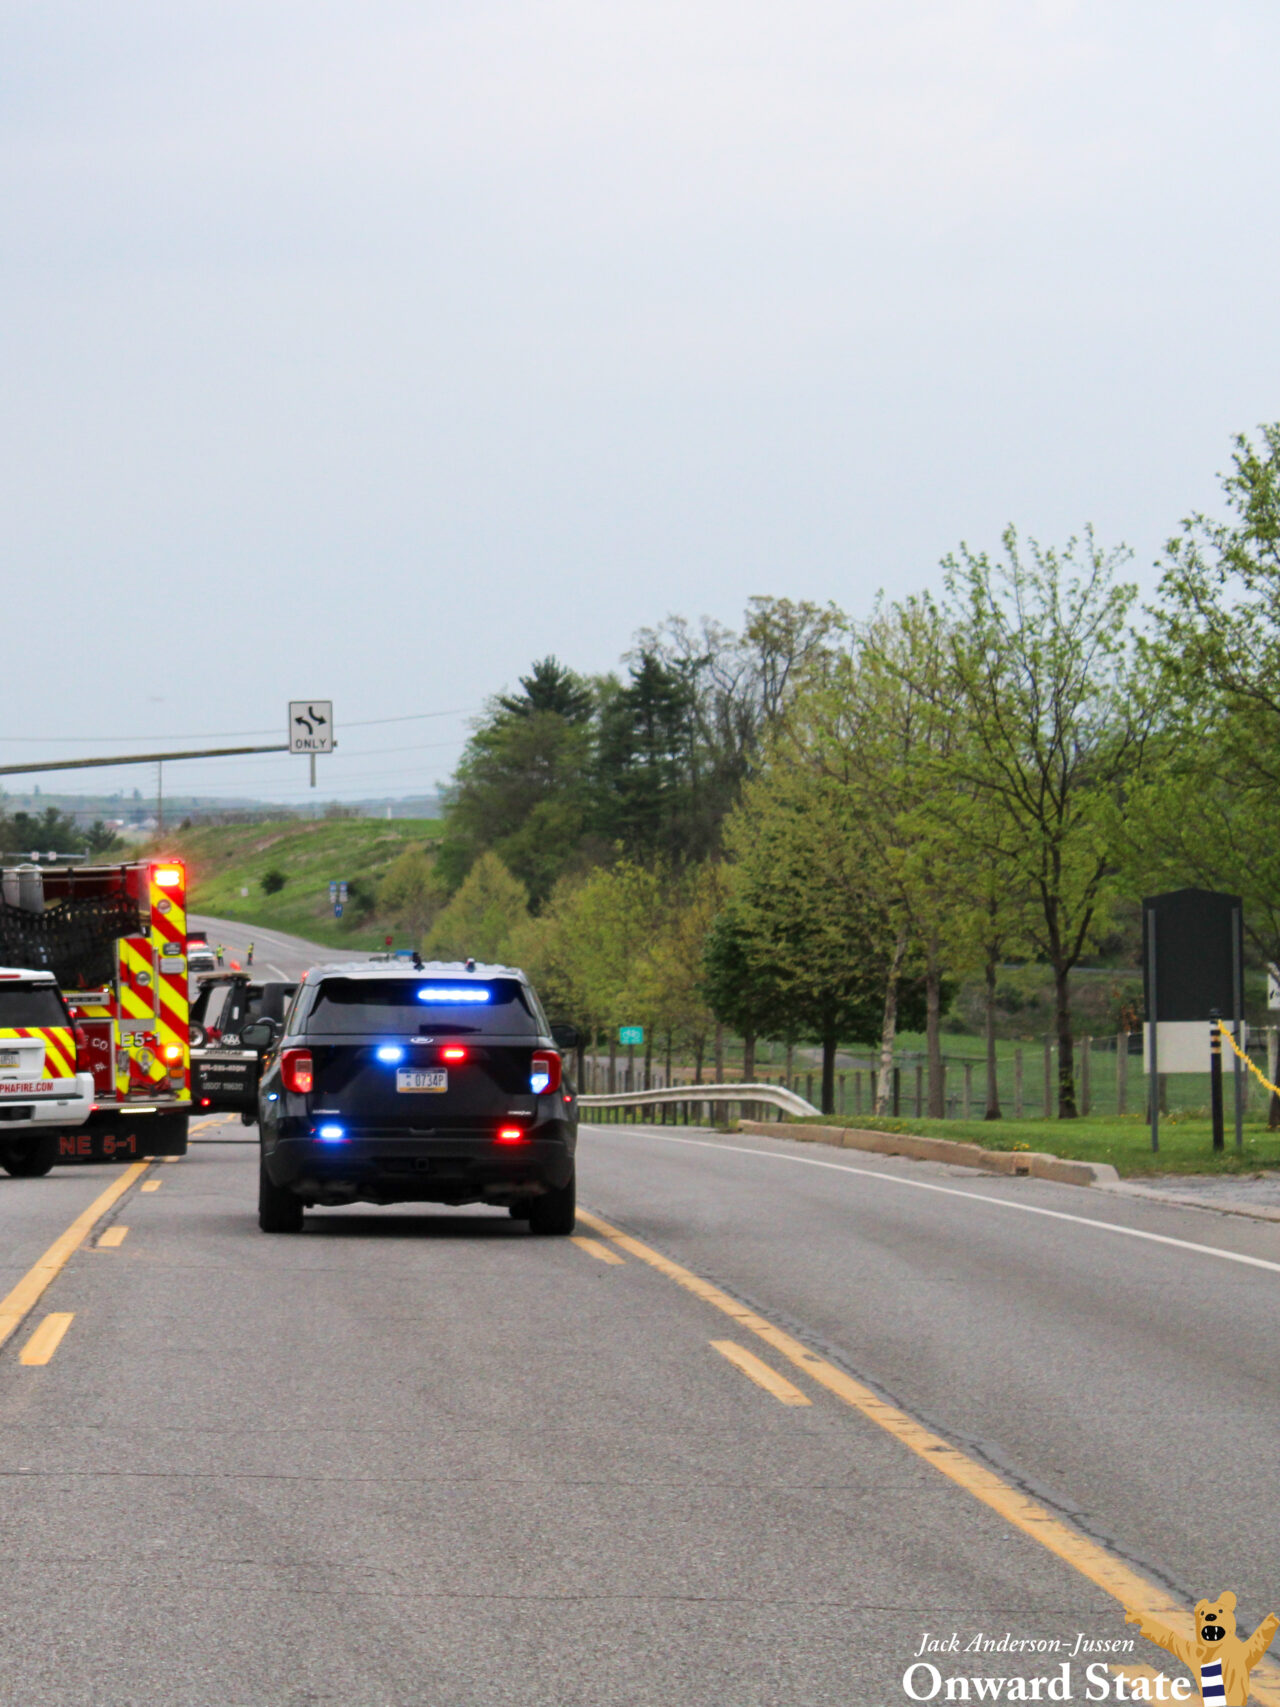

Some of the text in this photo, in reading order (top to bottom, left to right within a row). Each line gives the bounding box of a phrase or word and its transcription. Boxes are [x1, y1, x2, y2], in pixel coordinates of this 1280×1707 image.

[295, 738, 327, 749] ONLY
[120, 1031, 161, 1048] E5-1
[103, 1134, 137, 1154] 5-1
